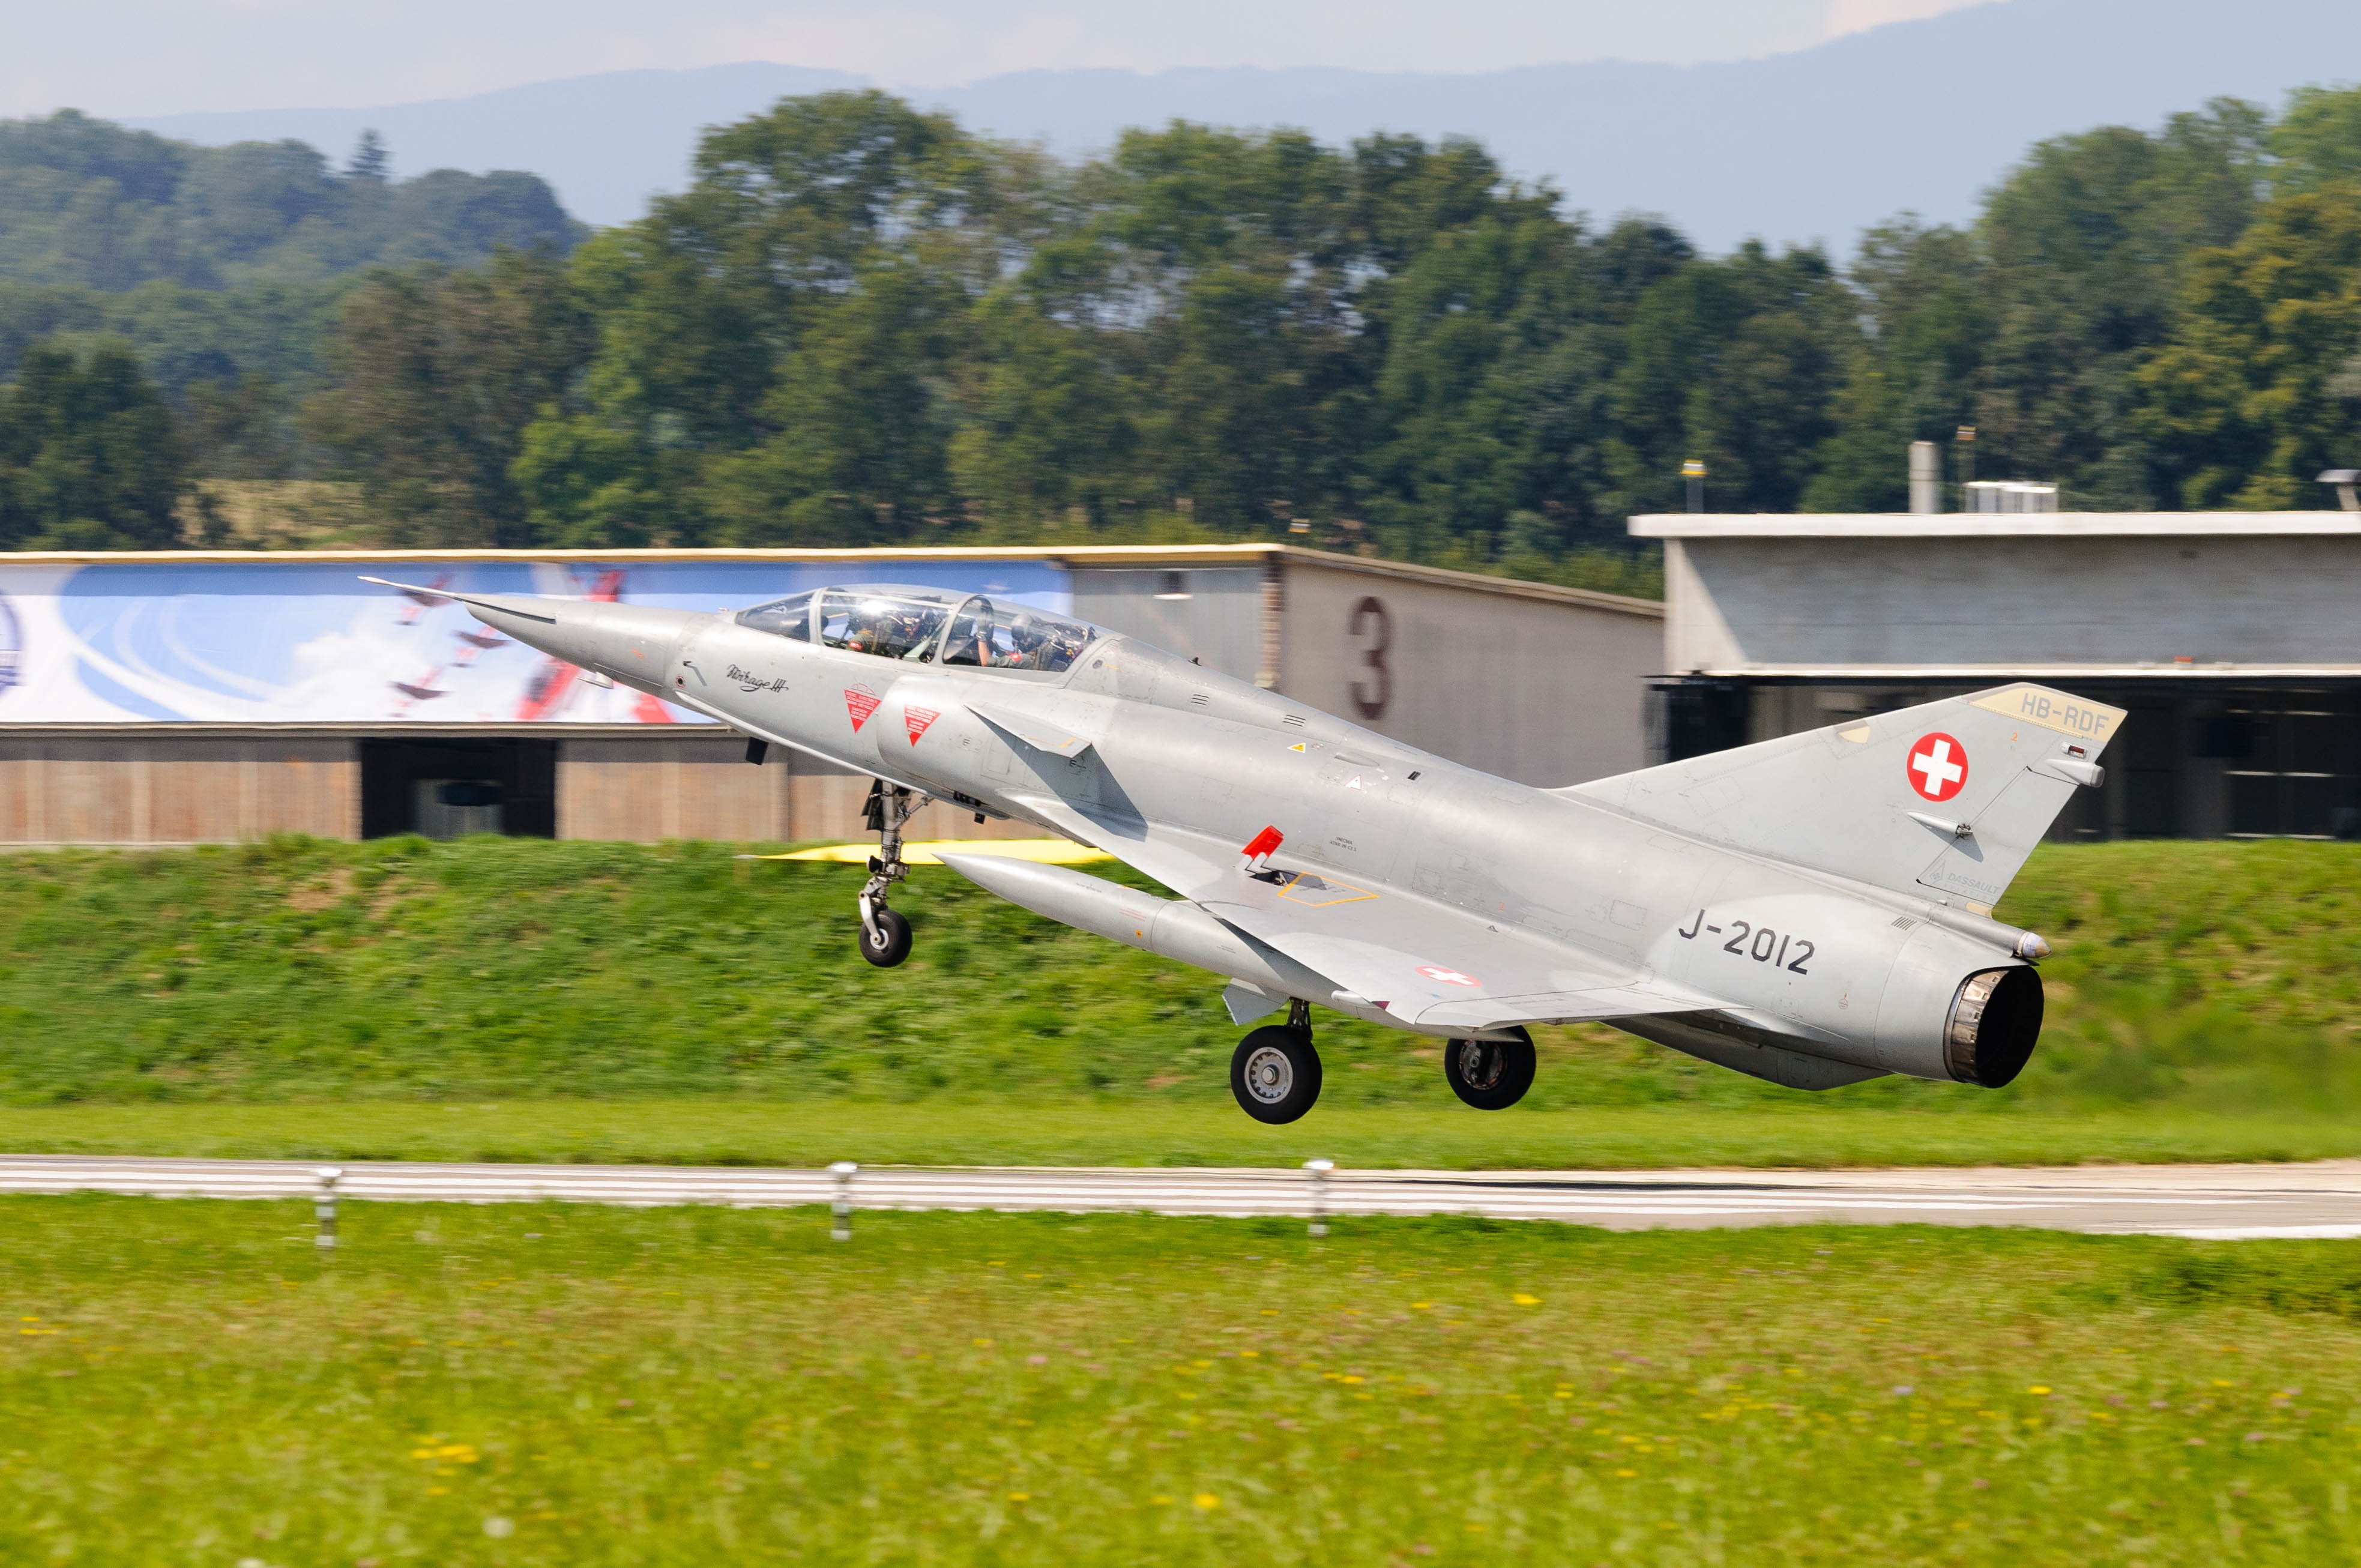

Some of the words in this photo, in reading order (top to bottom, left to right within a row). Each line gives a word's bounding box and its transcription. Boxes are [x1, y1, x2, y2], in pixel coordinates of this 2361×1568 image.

[1348, 596, 1393, 720] 3
[2021, 693, 2109, 734] HB-RDF
[1948, 873, 2001, 894] DASSAULT
[1678, 909, 1815, 975] J-2012
